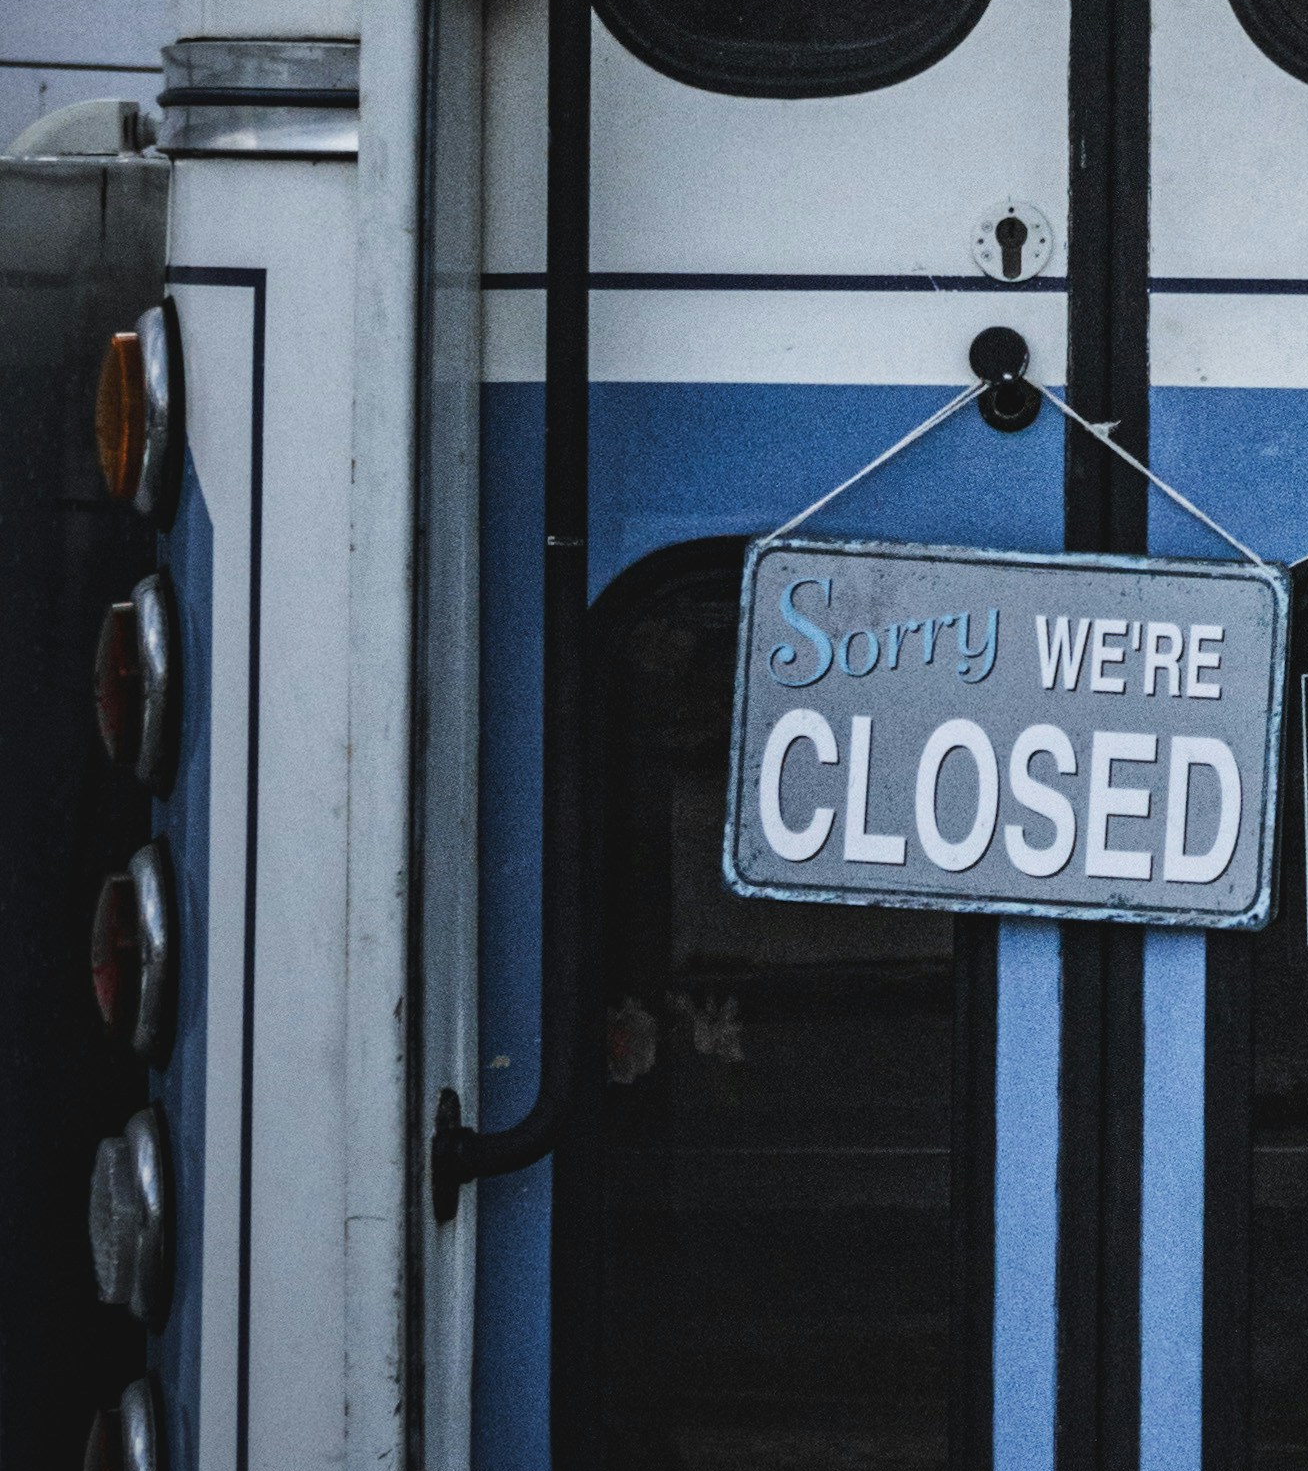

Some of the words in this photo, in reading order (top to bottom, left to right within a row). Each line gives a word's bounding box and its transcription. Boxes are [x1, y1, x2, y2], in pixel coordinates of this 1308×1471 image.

[768, 579, 1000, 689] Sorry
[1036, 615, 1226, 701] WE'RE
[759, 708, 1243, 885] CLOSED
